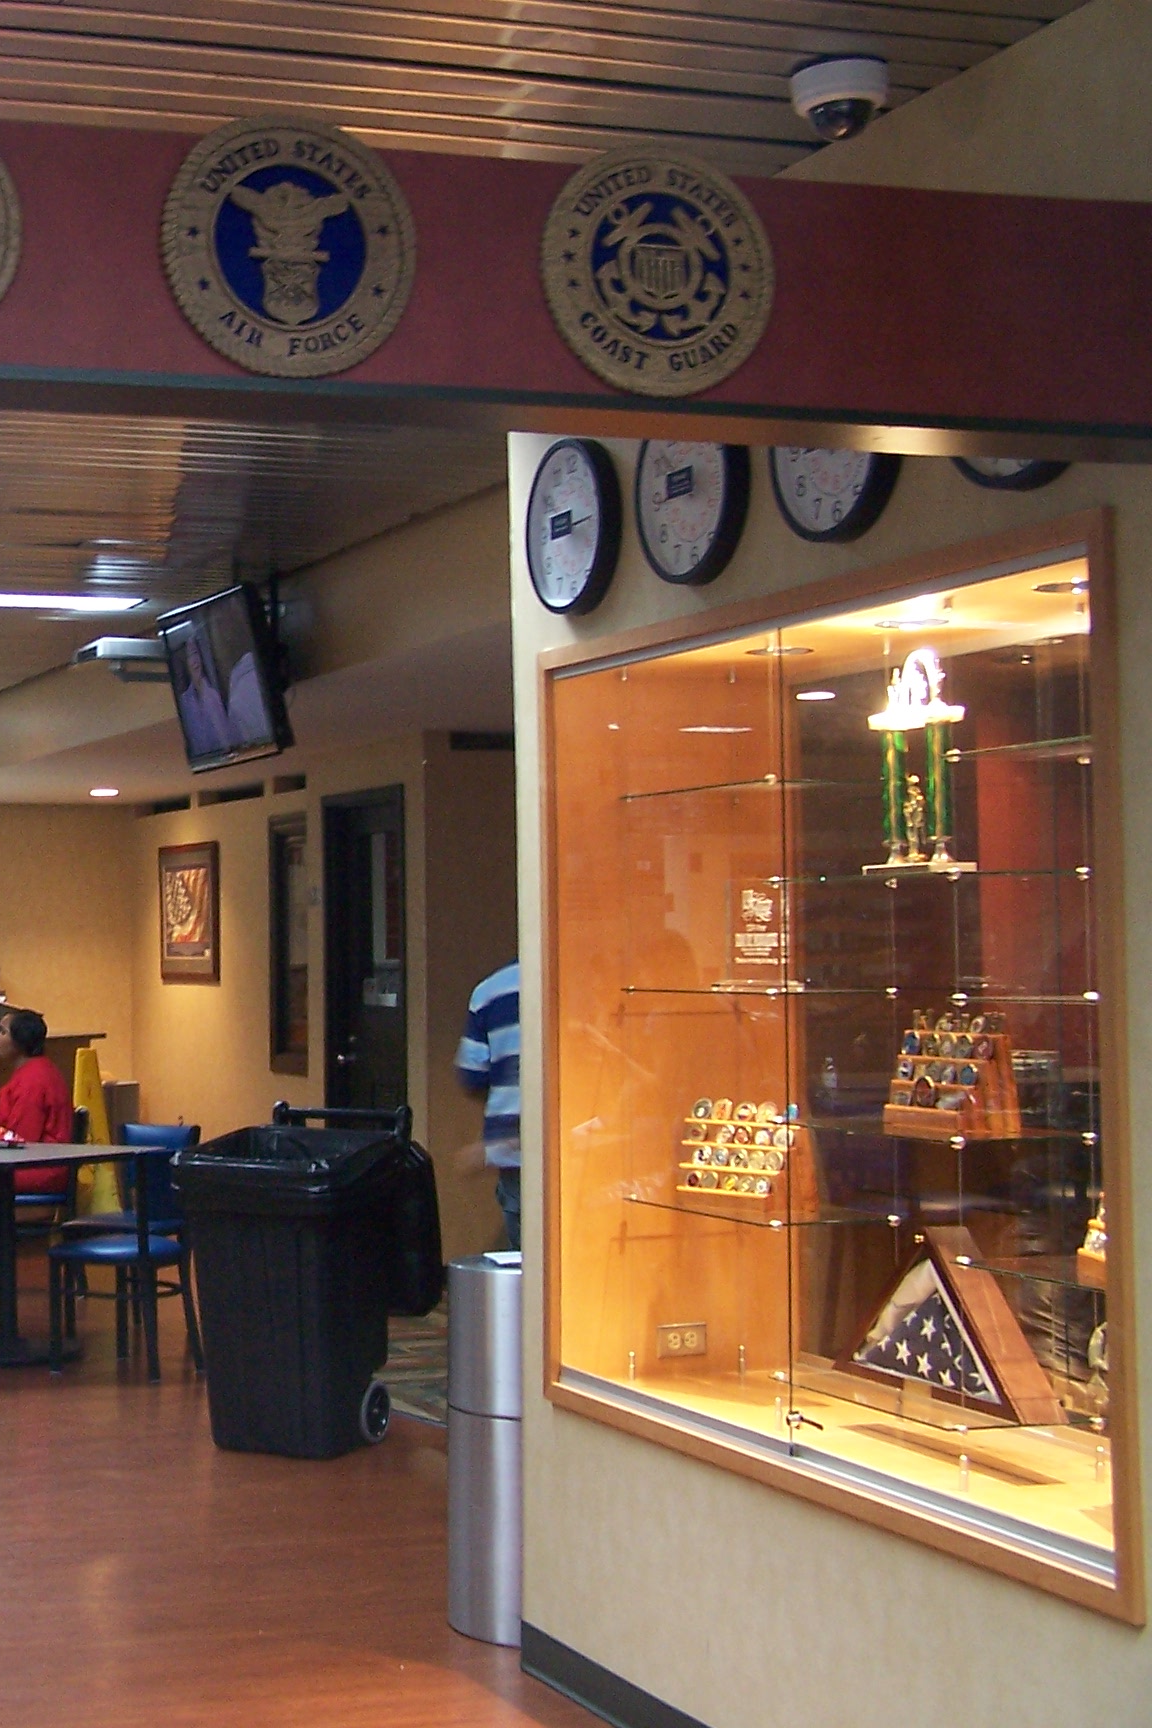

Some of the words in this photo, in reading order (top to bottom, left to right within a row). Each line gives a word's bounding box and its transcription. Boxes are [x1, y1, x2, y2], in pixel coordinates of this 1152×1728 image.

[200, 138, 279, 194] UNITED
[294, 140, 373, 200] STATES
[573, 166, 652, 217] UNITED
[666, 168, 739, 229] STATES
[219, 310, 264, 348] AIR
[287, 313, 366, 357] FORCE
[579, 311, 652, 371] COAST
[668, 323, 740, 373] GUARD
